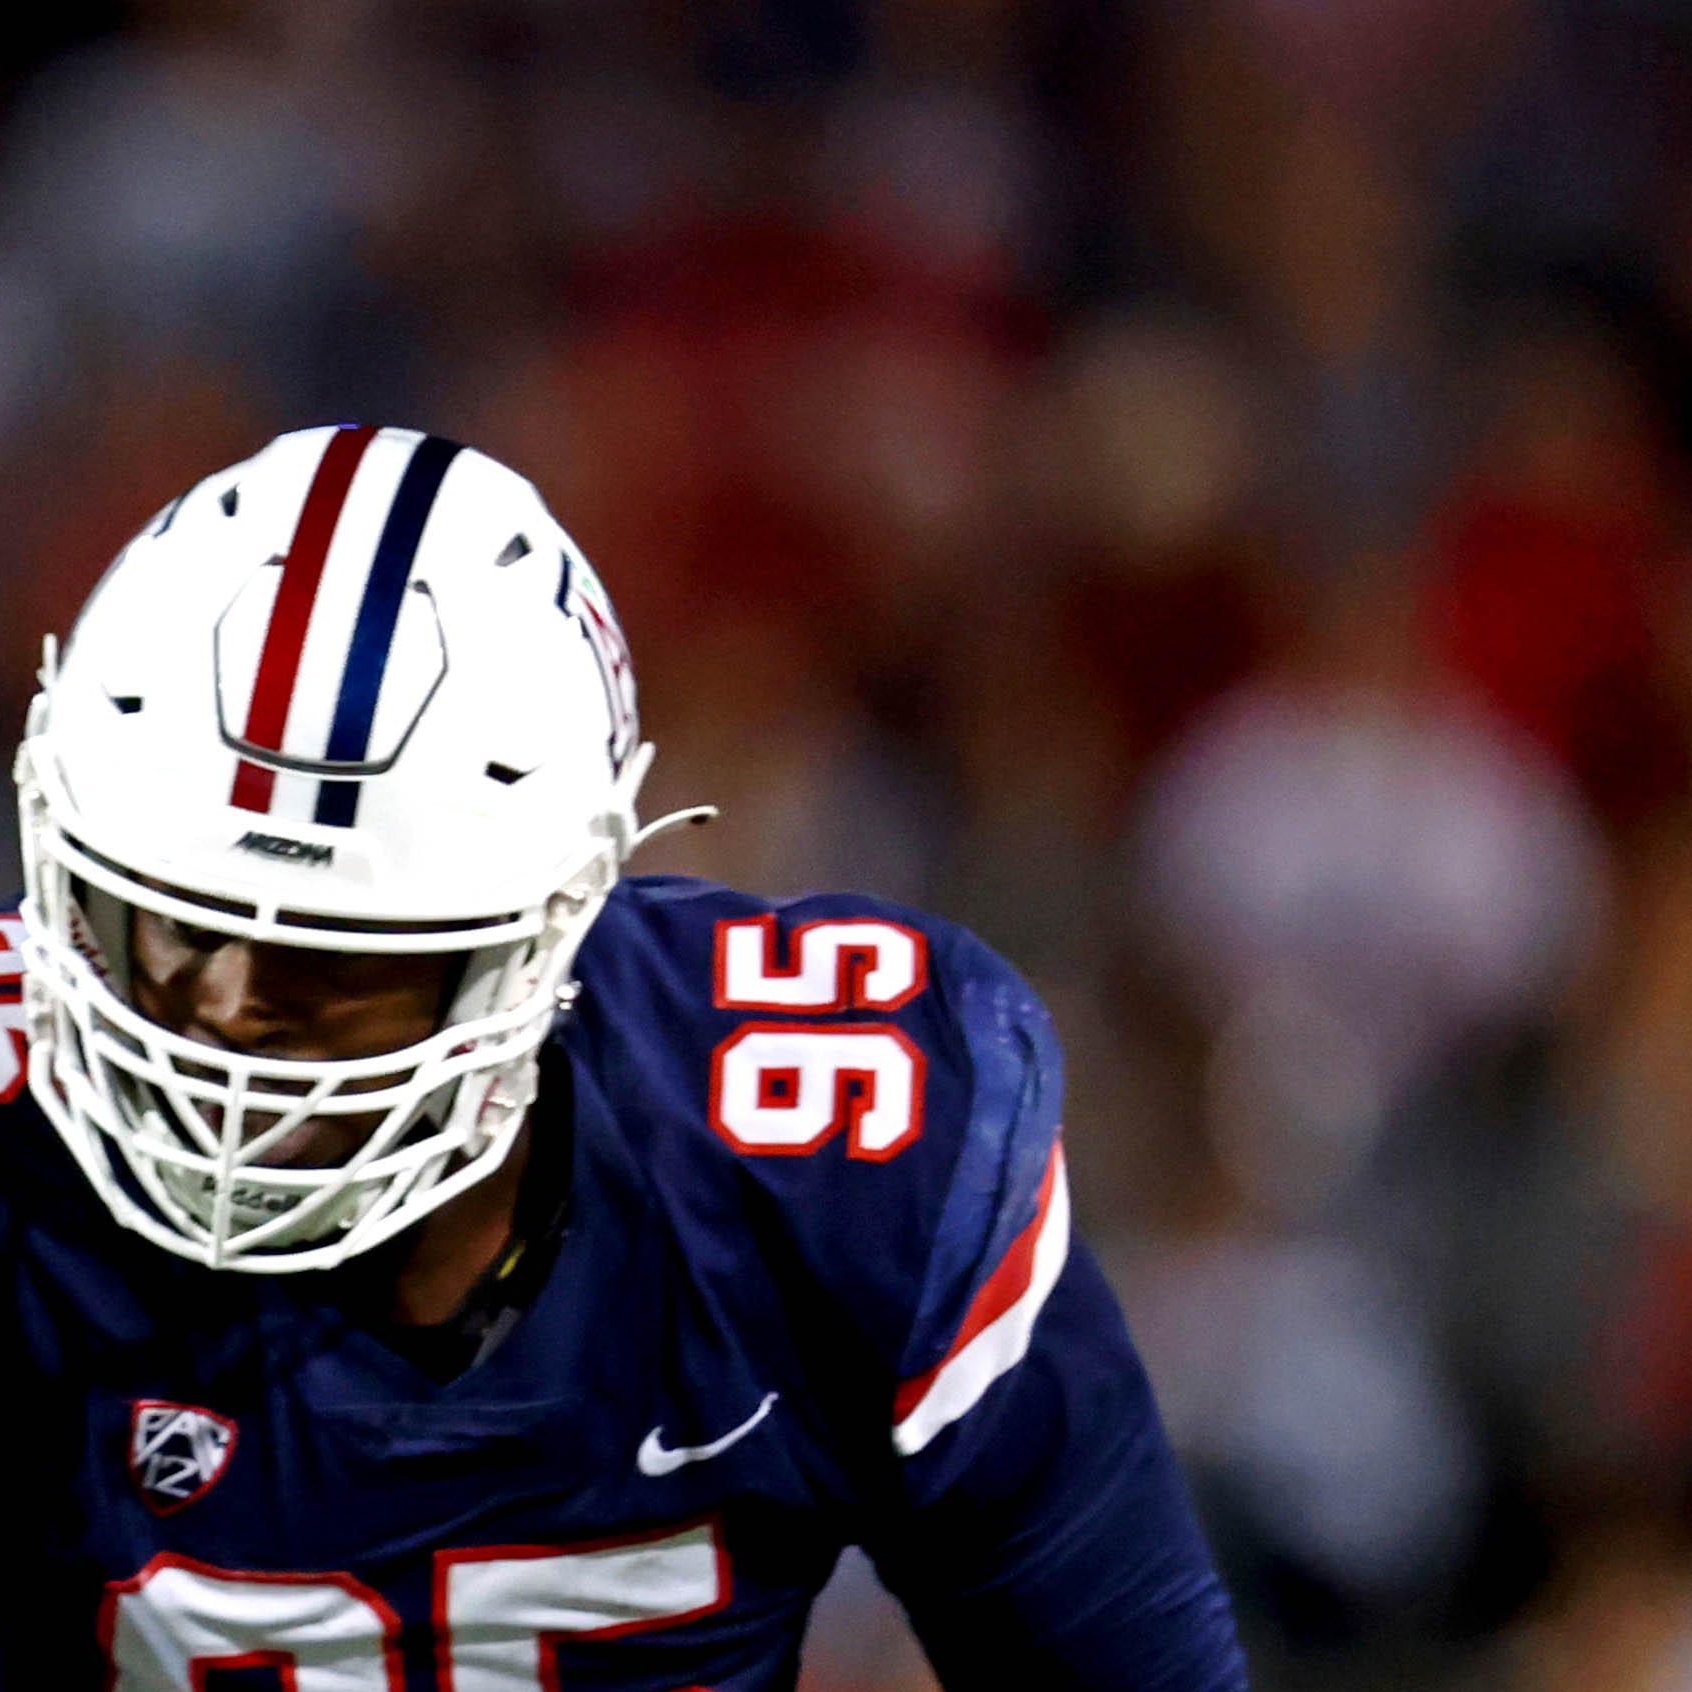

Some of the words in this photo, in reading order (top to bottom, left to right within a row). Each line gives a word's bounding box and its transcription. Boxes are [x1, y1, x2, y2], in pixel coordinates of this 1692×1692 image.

[708, 913, 929, 1163] 95
[134, 1408, 231, 1482] PAC
[143, 1453, 196, 1498] 12
